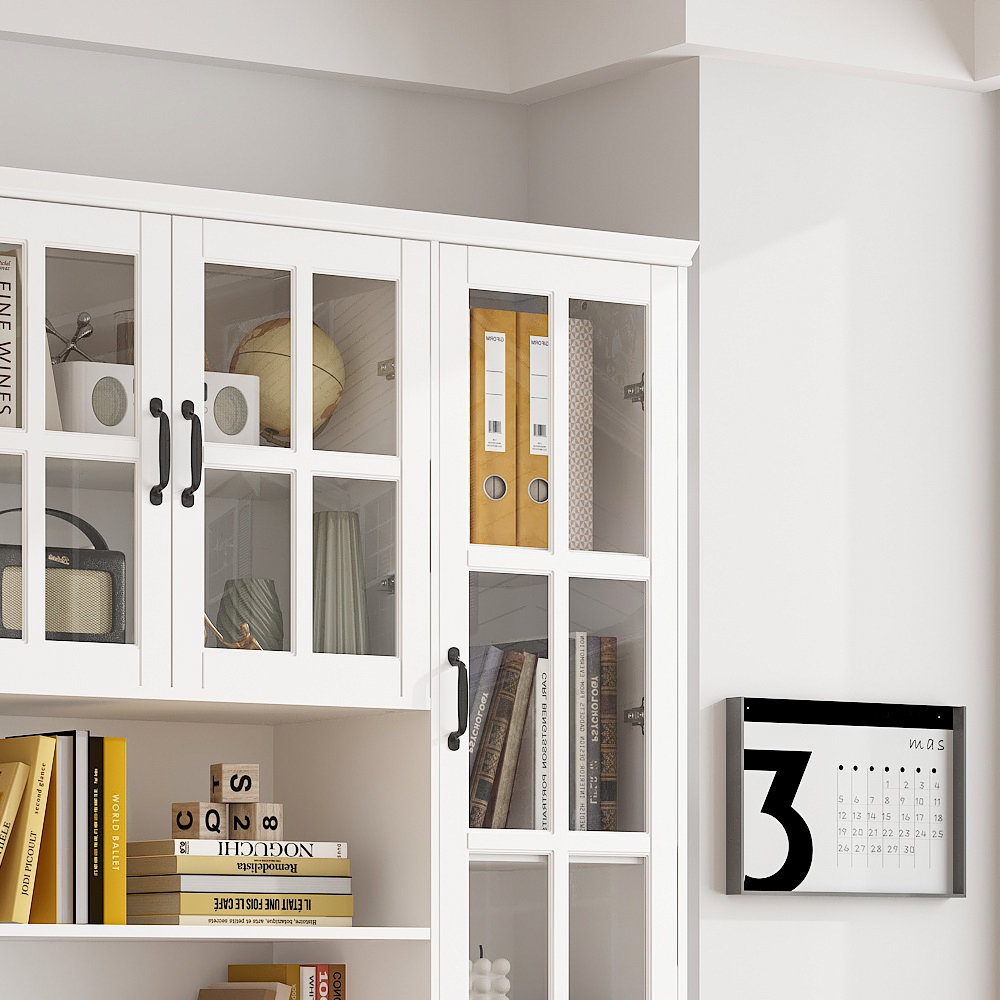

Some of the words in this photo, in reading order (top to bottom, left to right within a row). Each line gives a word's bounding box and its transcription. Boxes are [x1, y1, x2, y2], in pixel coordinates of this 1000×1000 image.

[34, 789, 42, 814] second
[38, 762, 47, 787] glance
[176, 810, 193, 831] C
[205, 809, 220, 834] Q
[262, 815, 278, 831] 8
[744, 749, 813, 891] 3
[25, 830, 37, 872] PICOULT
[218, 842, 314, 857] NOGUCHI
[237, 862, 298, 873] Remodelista
[21, 873, 31, 896] JODI
[214, 898, 234, 911] CAFÉ
[235, 899, 244, 910] LE
[246, 899, 263, 910] FOIS
[265, 899, 280, 911] UNE
[282, 899, 302, 912] ÉTAIT
[304, 899, 311, 911] IL
